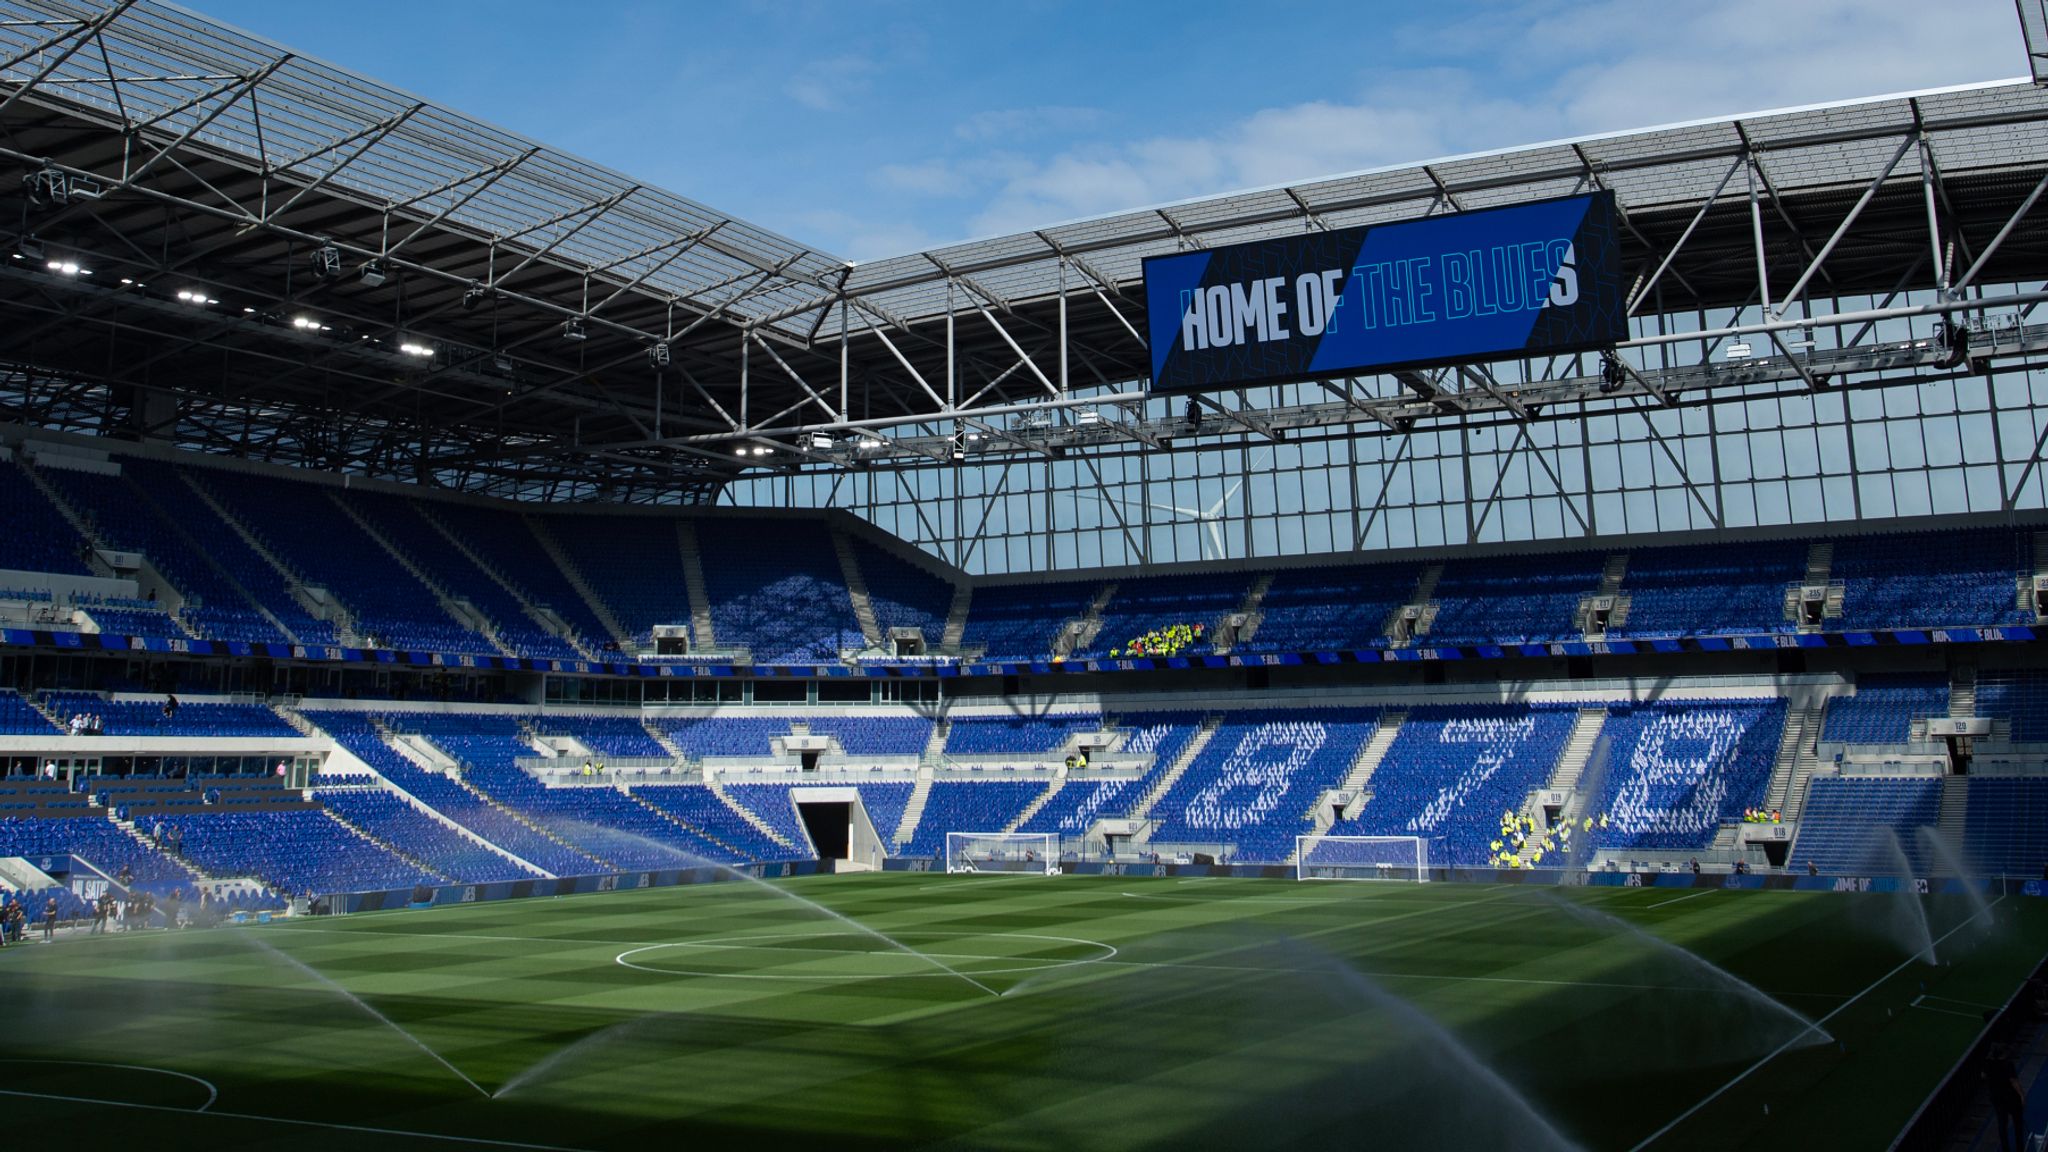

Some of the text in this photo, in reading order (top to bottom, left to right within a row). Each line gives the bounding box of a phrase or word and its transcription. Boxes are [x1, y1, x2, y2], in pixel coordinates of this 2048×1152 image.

[1180, 238, 1580, 351] HOME OF THE BLUES
[1955, 722, 1967, 730] 120
